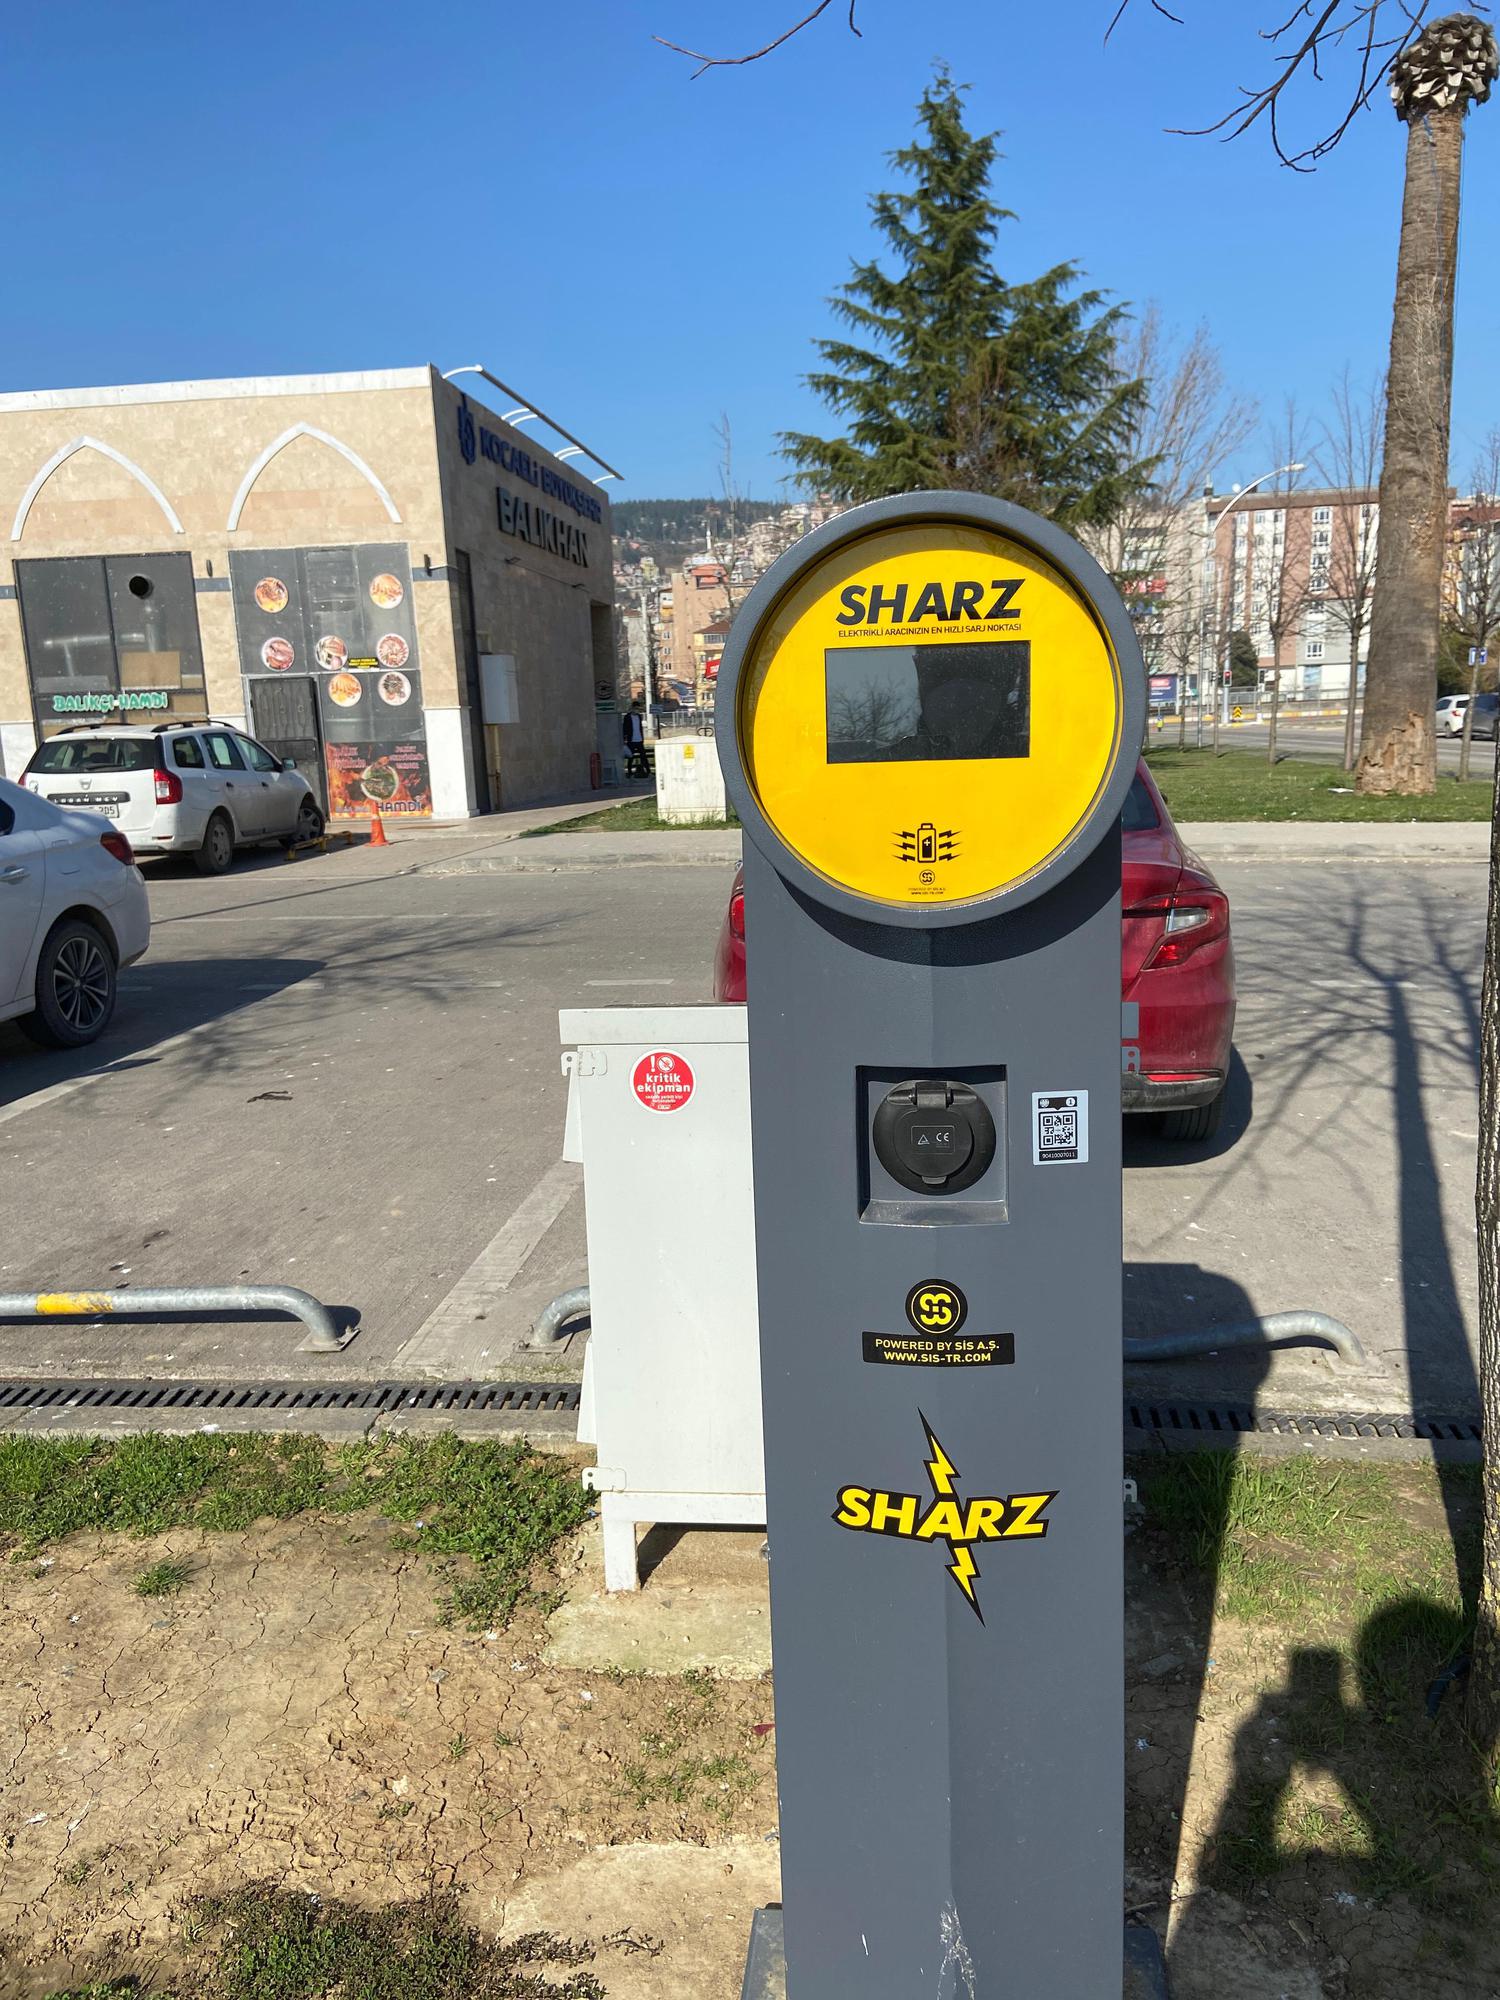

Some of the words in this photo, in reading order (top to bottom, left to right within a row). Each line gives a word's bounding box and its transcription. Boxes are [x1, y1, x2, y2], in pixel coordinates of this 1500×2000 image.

[836, 578, 1026, 626] SHARZ
[885, 627, 930, 636] ARACINIZIN
[931, 627, 942, 635] EN
[944, 625, 964, 634] HIZLI
[987, 624, 1022, 632] NOKTASI
[645, 1073, 681, 1083] kritik
[637, 1082, 691, 1094] ekipman
[935, 1132, 950, 1142] CE
[875, 1338, 933, 1351] POWERED
[936, 1341, 953, 1350] BY
[883, 1351, 992, 1363] WWW.SIS-TR.COM
[836, 1487, 1052, 1541] SHARZ
